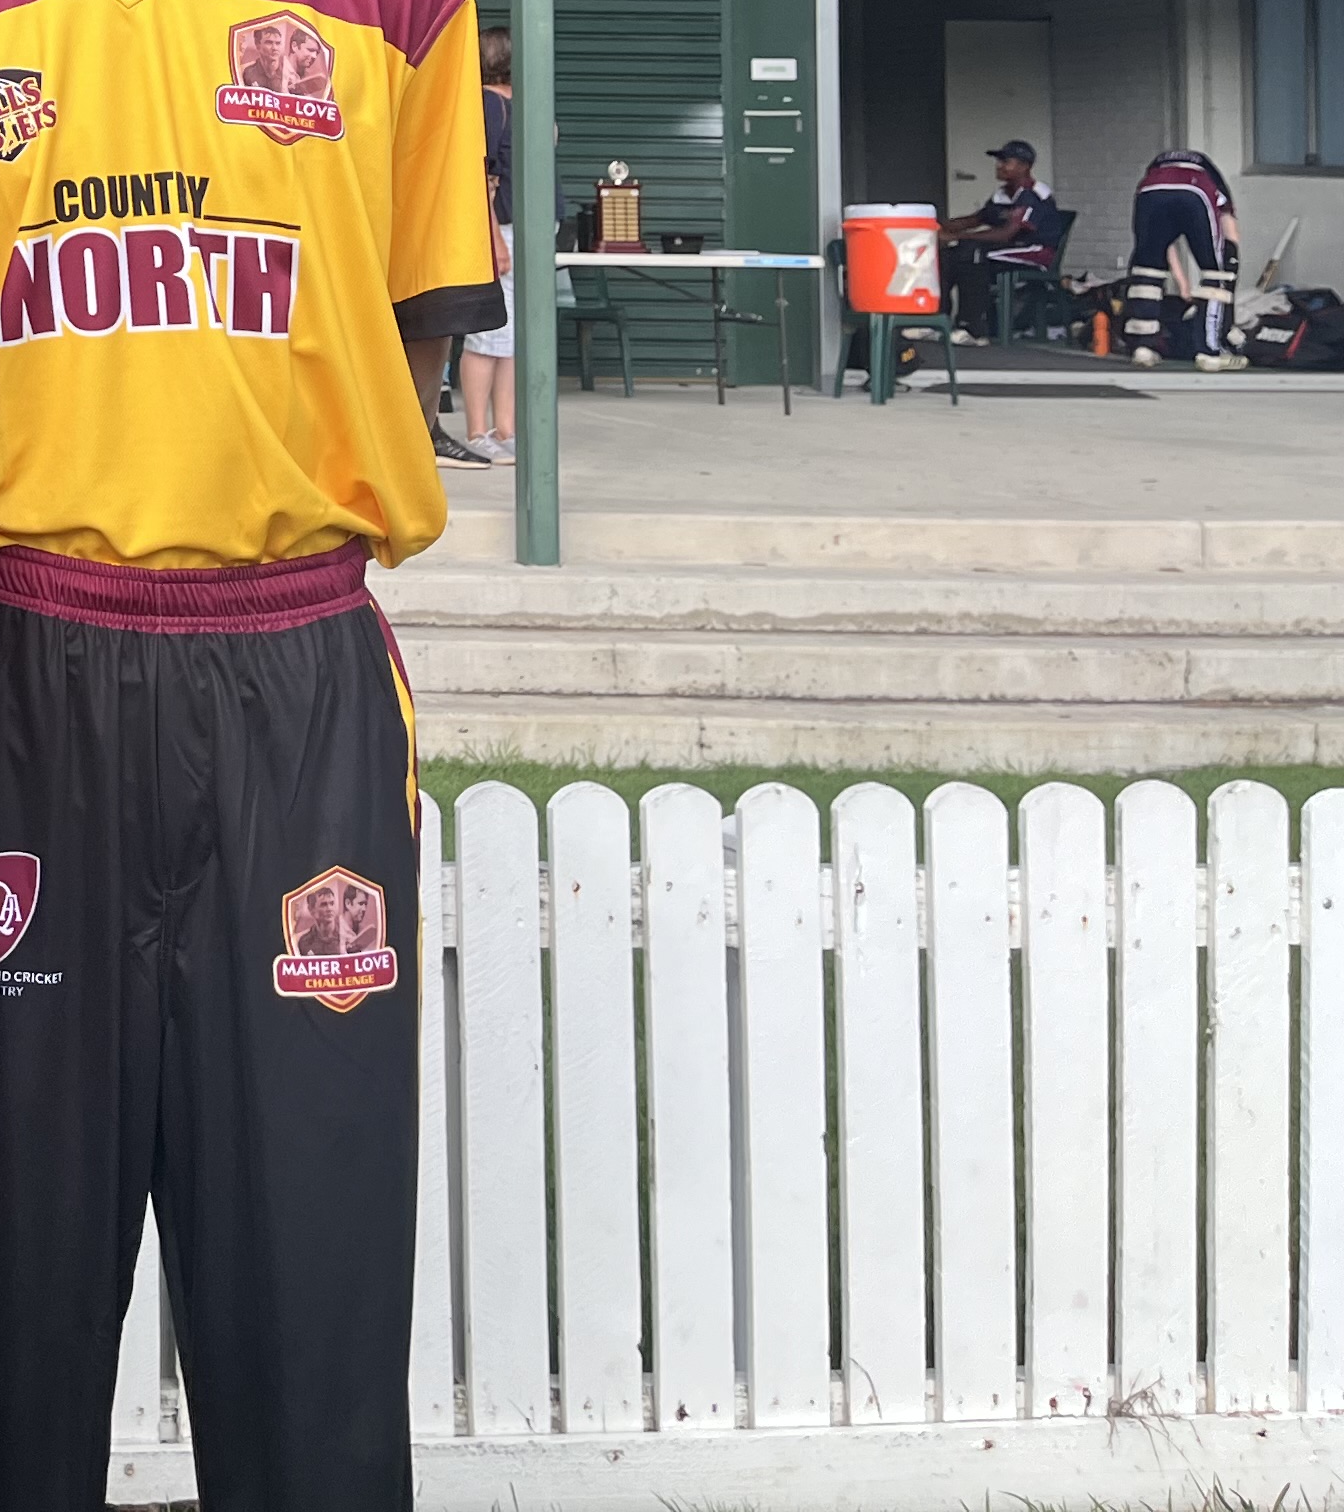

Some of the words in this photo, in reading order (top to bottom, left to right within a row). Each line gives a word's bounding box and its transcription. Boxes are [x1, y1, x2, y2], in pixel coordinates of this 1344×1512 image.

[224, 91, 281, 111] MAHER
[295, 101, 336, 121] LOVE
[247, 108, 315, 129] CHALLENGE
[282, 961, 341, 976] MAHER
[354, 954, 390, 973] LOVE
[13, 972, 63, 985] CRICKET
[305, 974, 375, 988] CHALLENGE
